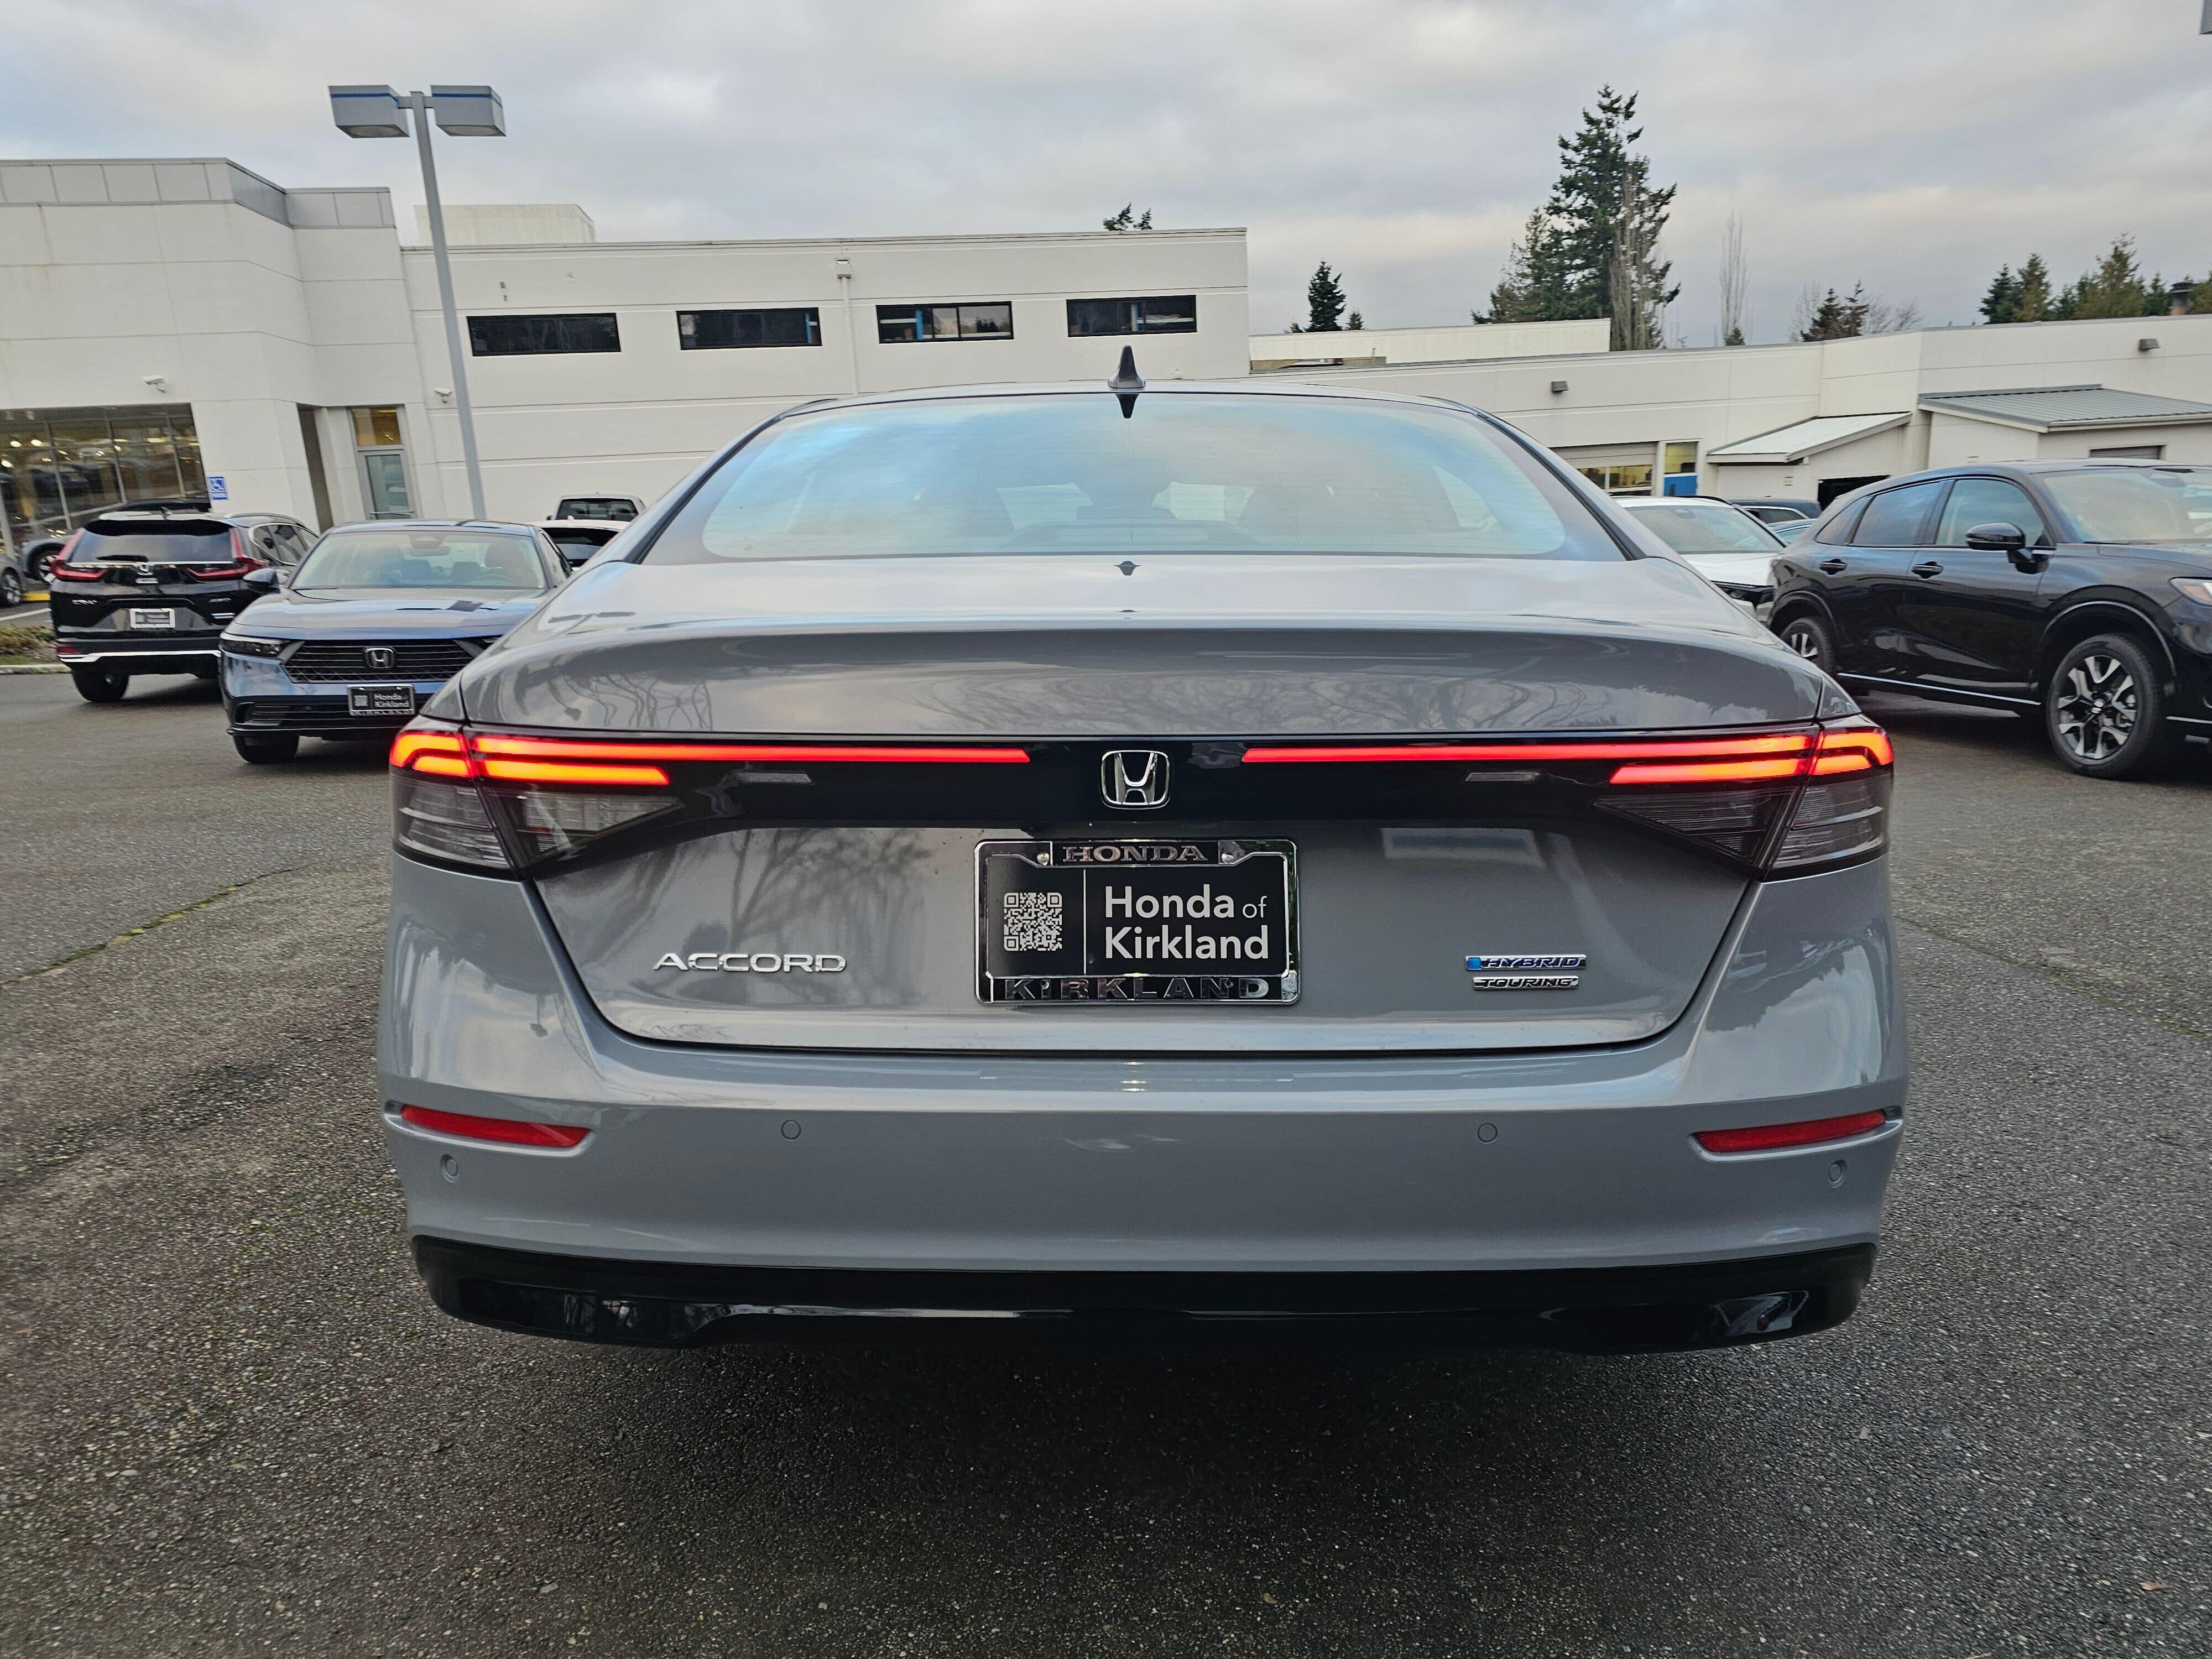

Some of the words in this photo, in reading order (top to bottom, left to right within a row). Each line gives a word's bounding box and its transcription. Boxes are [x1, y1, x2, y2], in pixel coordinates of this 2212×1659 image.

[1062, 845, 1208, 862] HONDA
[1105, 884, 1235, 919] Honda
[1242, 896, 1267, 919] of
[1105, 925, 1269, 959] Kirkland
[652, 952, 847, 973] ACCORD
[1480, 957, 1582, 968] HYBRID
[1004, 977, 1270, 1000] KIRKLAND
[1480, 978, 1574, 988] TOURING
